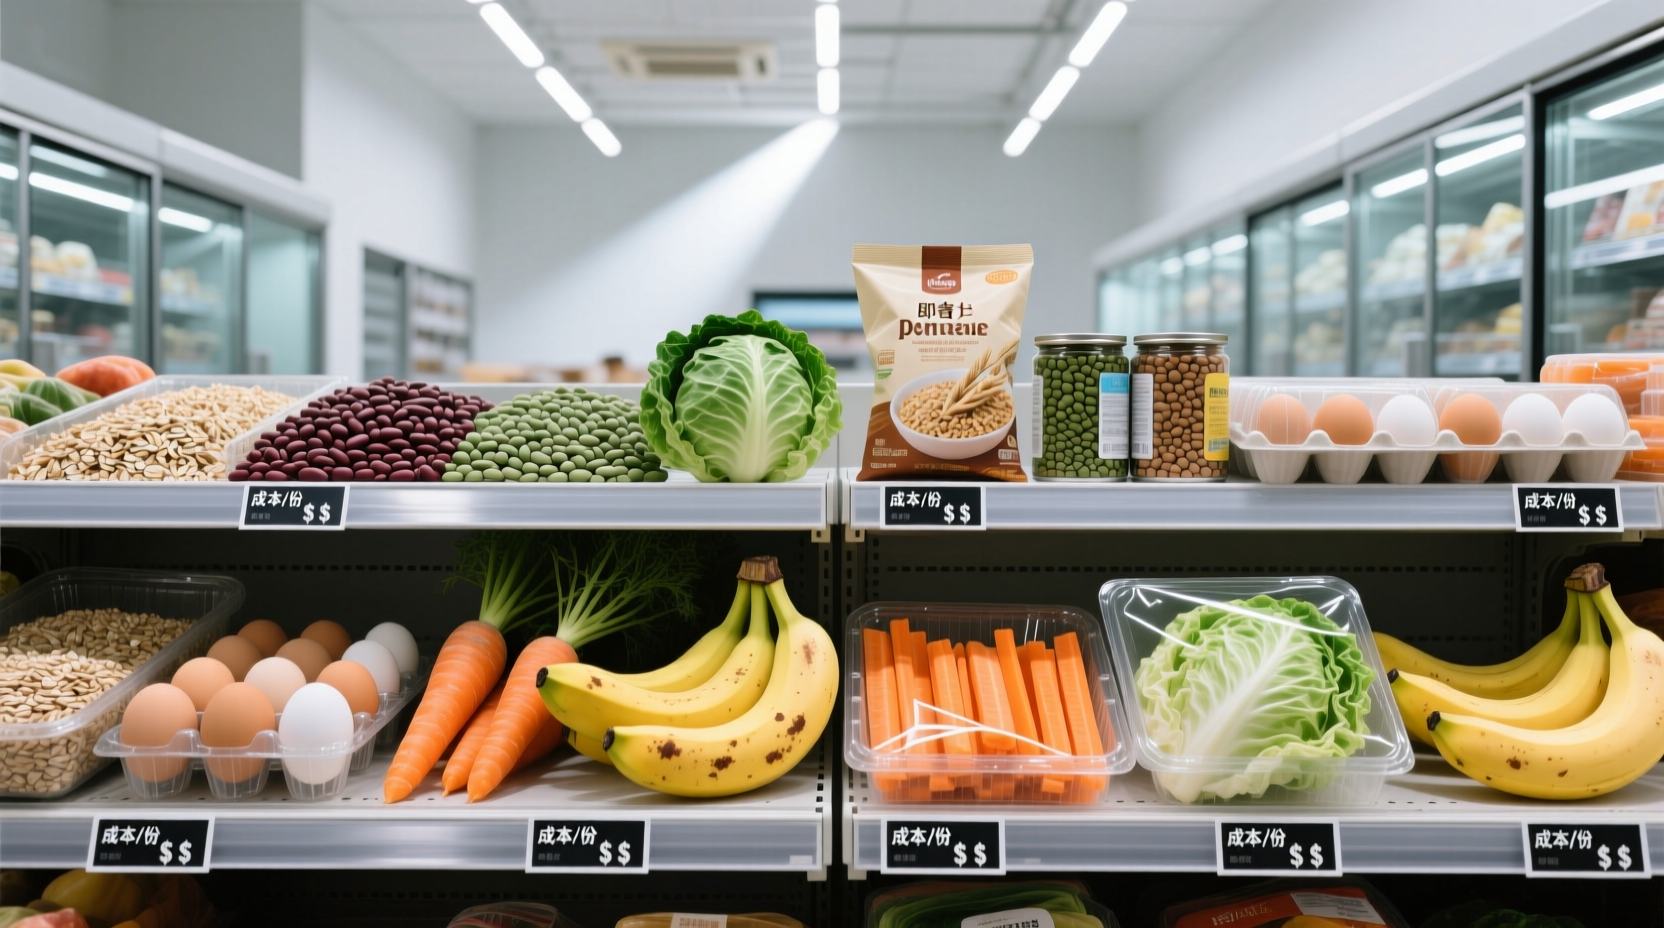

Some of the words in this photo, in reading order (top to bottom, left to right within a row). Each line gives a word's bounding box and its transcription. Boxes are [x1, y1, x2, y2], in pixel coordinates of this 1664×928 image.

[251, 490, 302, 507] 成本/份
[890, 490, 941, 507] 成本/份
[1525, 492, 1575, 509] 成本/份
[102, 826, 160, 846] 成本/份
[538, 826, 597, 846] 成本/份
[892, 827, 951, 847] 成本/份
[1228, 828, 1285, 848] 成本/份
[1535, 829, 1592, 849] 成本/份
